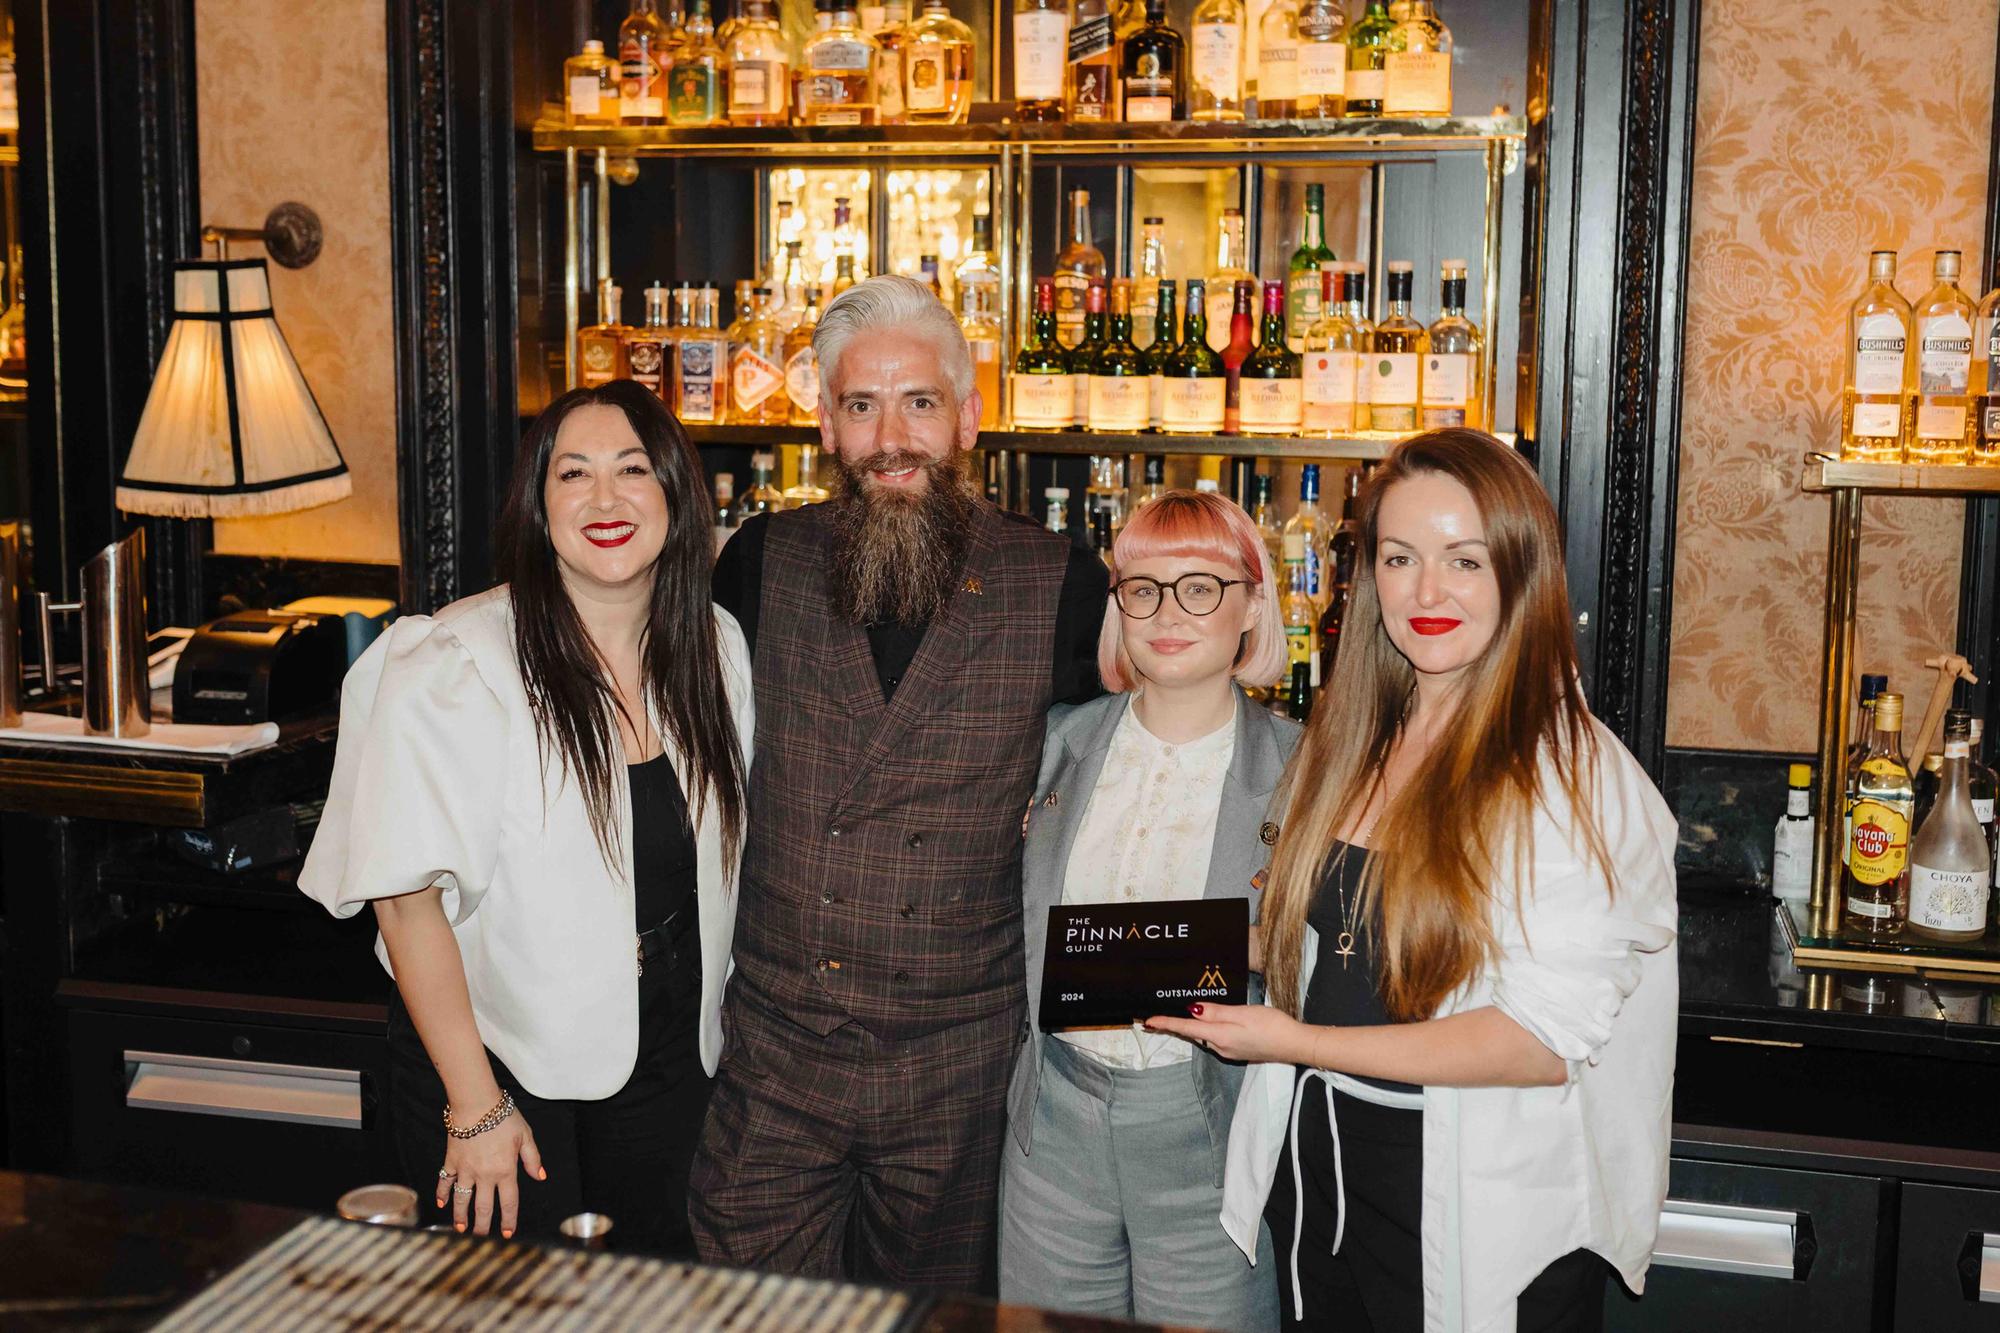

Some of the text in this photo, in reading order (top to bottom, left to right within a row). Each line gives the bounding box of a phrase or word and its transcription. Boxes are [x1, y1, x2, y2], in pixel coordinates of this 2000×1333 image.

[1290, 277, 1321, 291] JAMES
[1859, 339, 1904, 351] BUSHMILLS
[1924, 339, 1970, 352] BUSHMILLS
[1858, 839, 1883, 854] Club
[1854, 862, 1885, 873] ORIGINAL
[1931, 872, 1973, 883] CHOYA
[1066, 923, 1189, 942] PINNACLE
[1065, 945, 1103, 953] GUIDE
[1061, 993, 1084, 1001] 2024
[1156, 988, 1228, 998] OUTSTANDING
